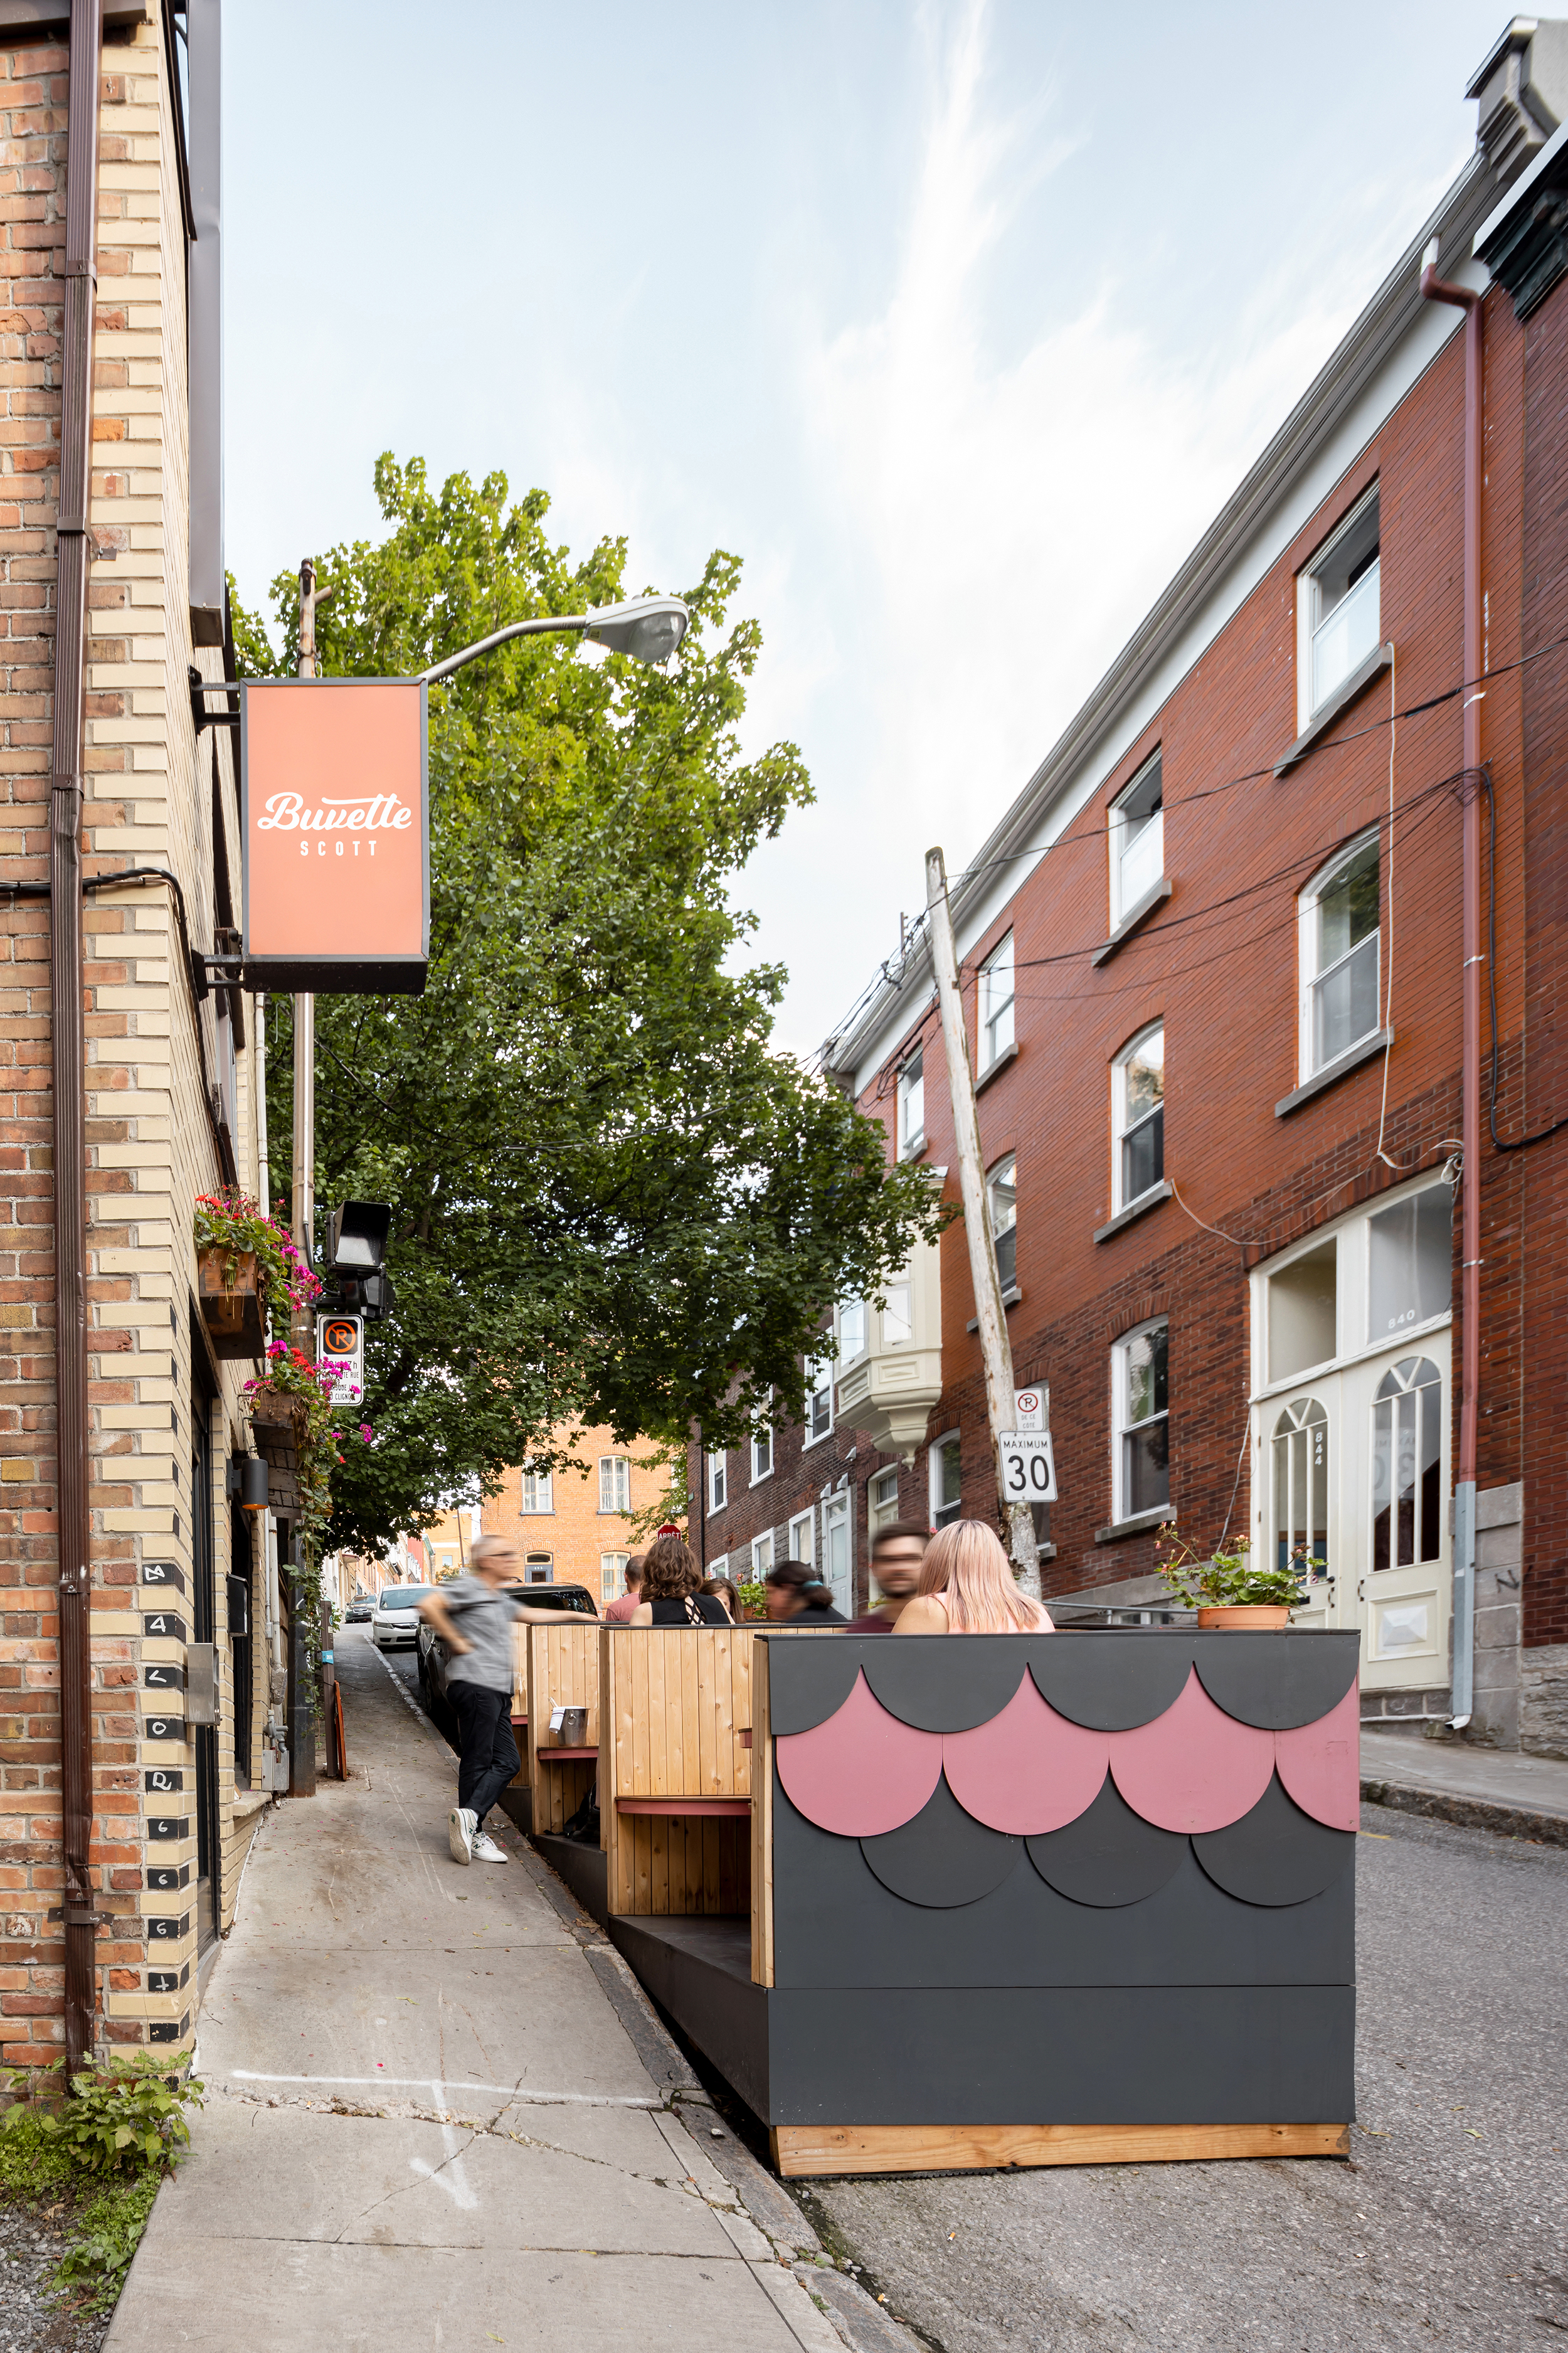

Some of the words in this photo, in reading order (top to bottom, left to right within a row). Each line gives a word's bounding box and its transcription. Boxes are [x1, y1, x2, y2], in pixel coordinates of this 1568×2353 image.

[257, 792, 412, 831] Buvette
[300, 841, 377, 856] SCOTT
[1388, 1309, 1416, 1329] 840
[1004, 1440, 1048, 1448] MAXIMUM
[1315, 1431, 1323, 1465] 844
[1008, 1455, 1049, 1491] 30
